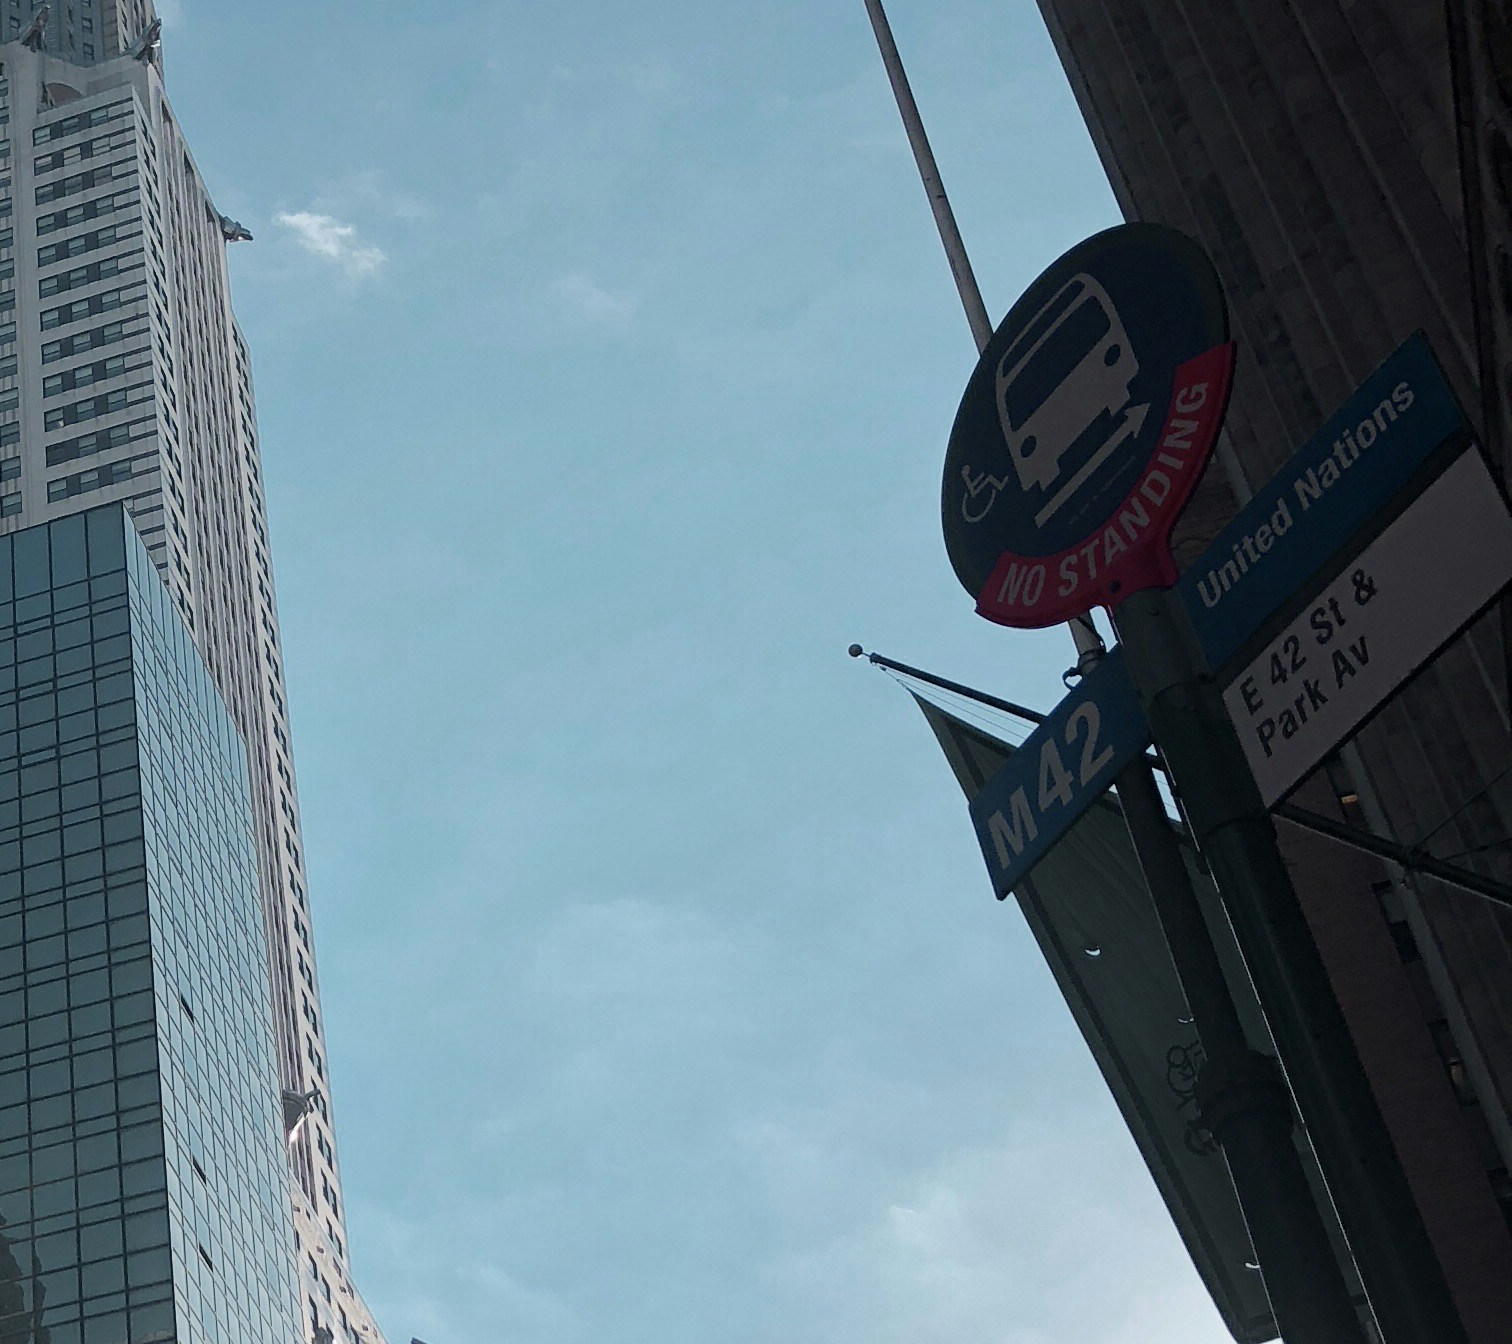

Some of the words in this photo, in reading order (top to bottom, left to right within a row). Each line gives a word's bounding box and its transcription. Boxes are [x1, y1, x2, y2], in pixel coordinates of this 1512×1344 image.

[998, 562, 1046, 606] NO
[1057, 382, 1209, 597] STANDING
[1196, 497, 1293, 607] United
[1293, 380, 1415, 511] Nations
[1240, 675, 1263, 716] E
[1271, 635, 1306, 685] 42
[1309, 598, 1346, 645] St
[1351, 568, 1377, 606] &
[1257, 679, 1328, 757] Park
[1332, 636, 1369, 689] Av
[987, 701, 1115, 870] M42
